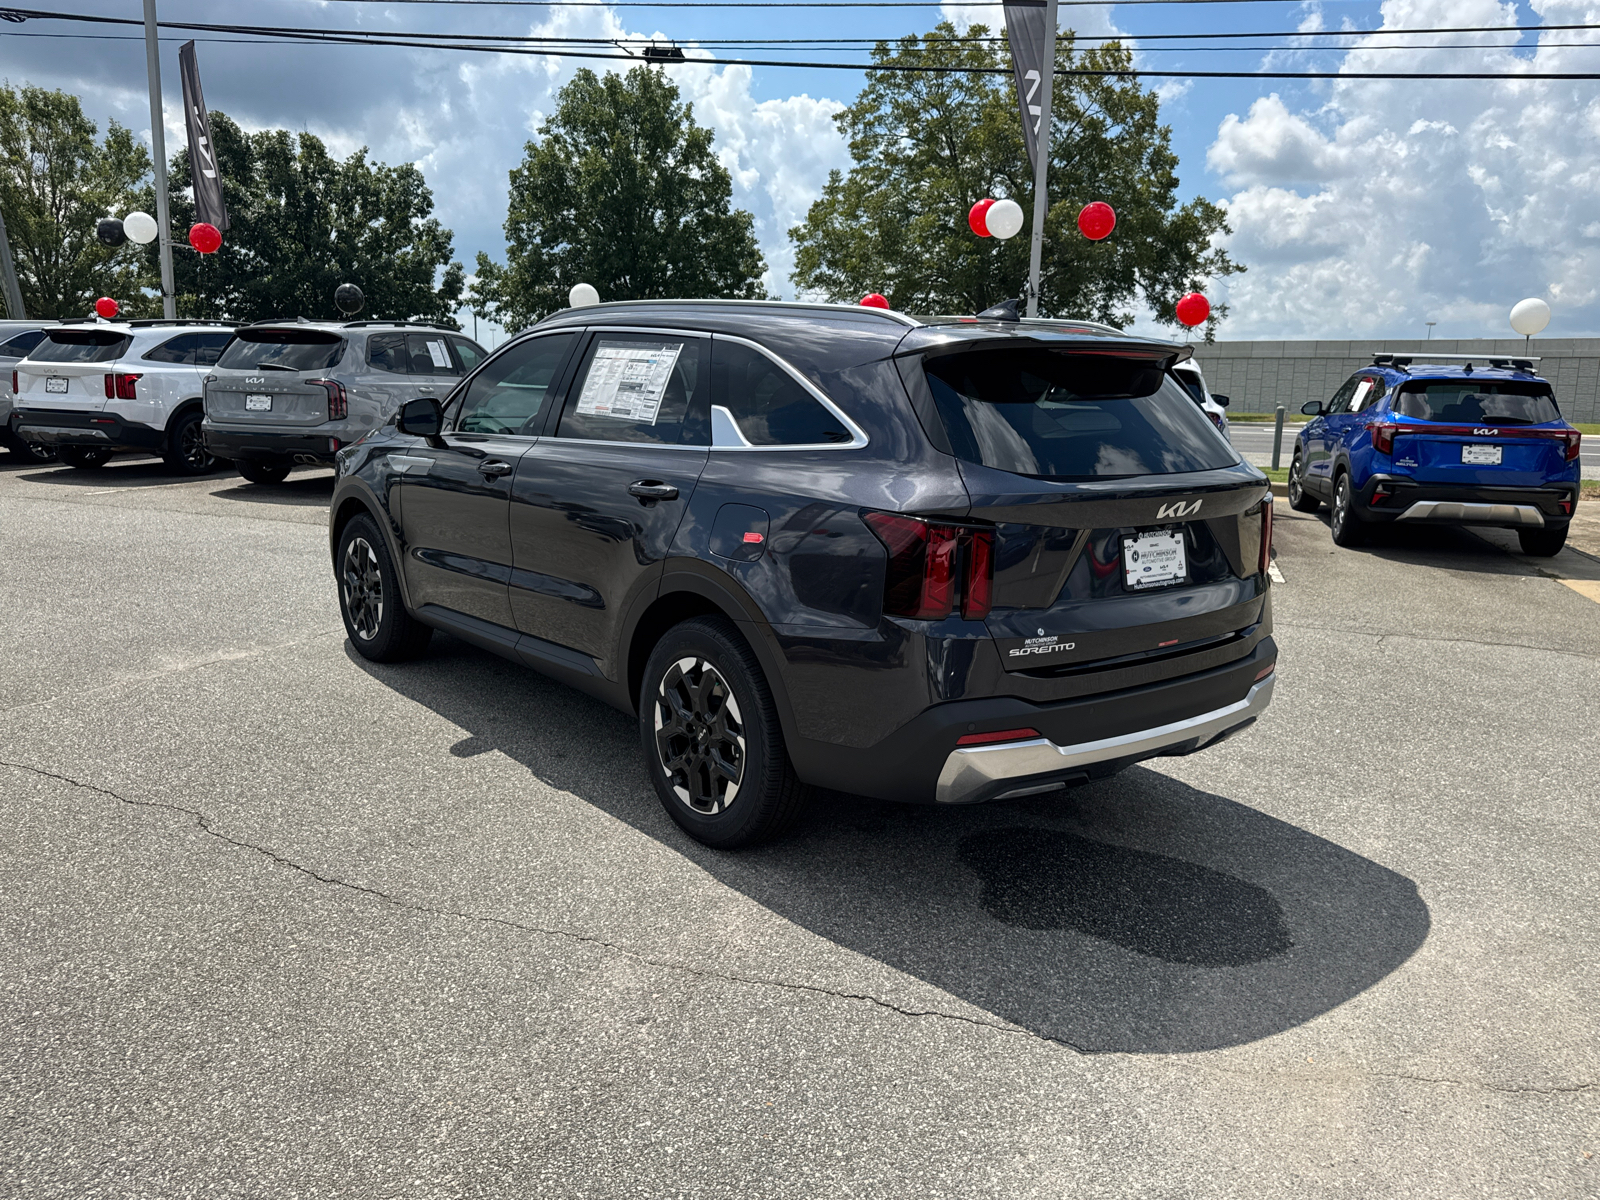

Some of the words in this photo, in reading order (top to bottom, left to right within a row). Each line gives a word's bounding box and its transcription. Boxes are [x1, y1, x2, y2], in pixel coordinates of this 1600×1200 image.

[1473, 428, 1499, 436] KIA
[1156, 499, 1203, 519] KIA
[1024, 635, 1059, 645] HUTCHINSON
[1009, 642, 1076, 657] SORENTO
